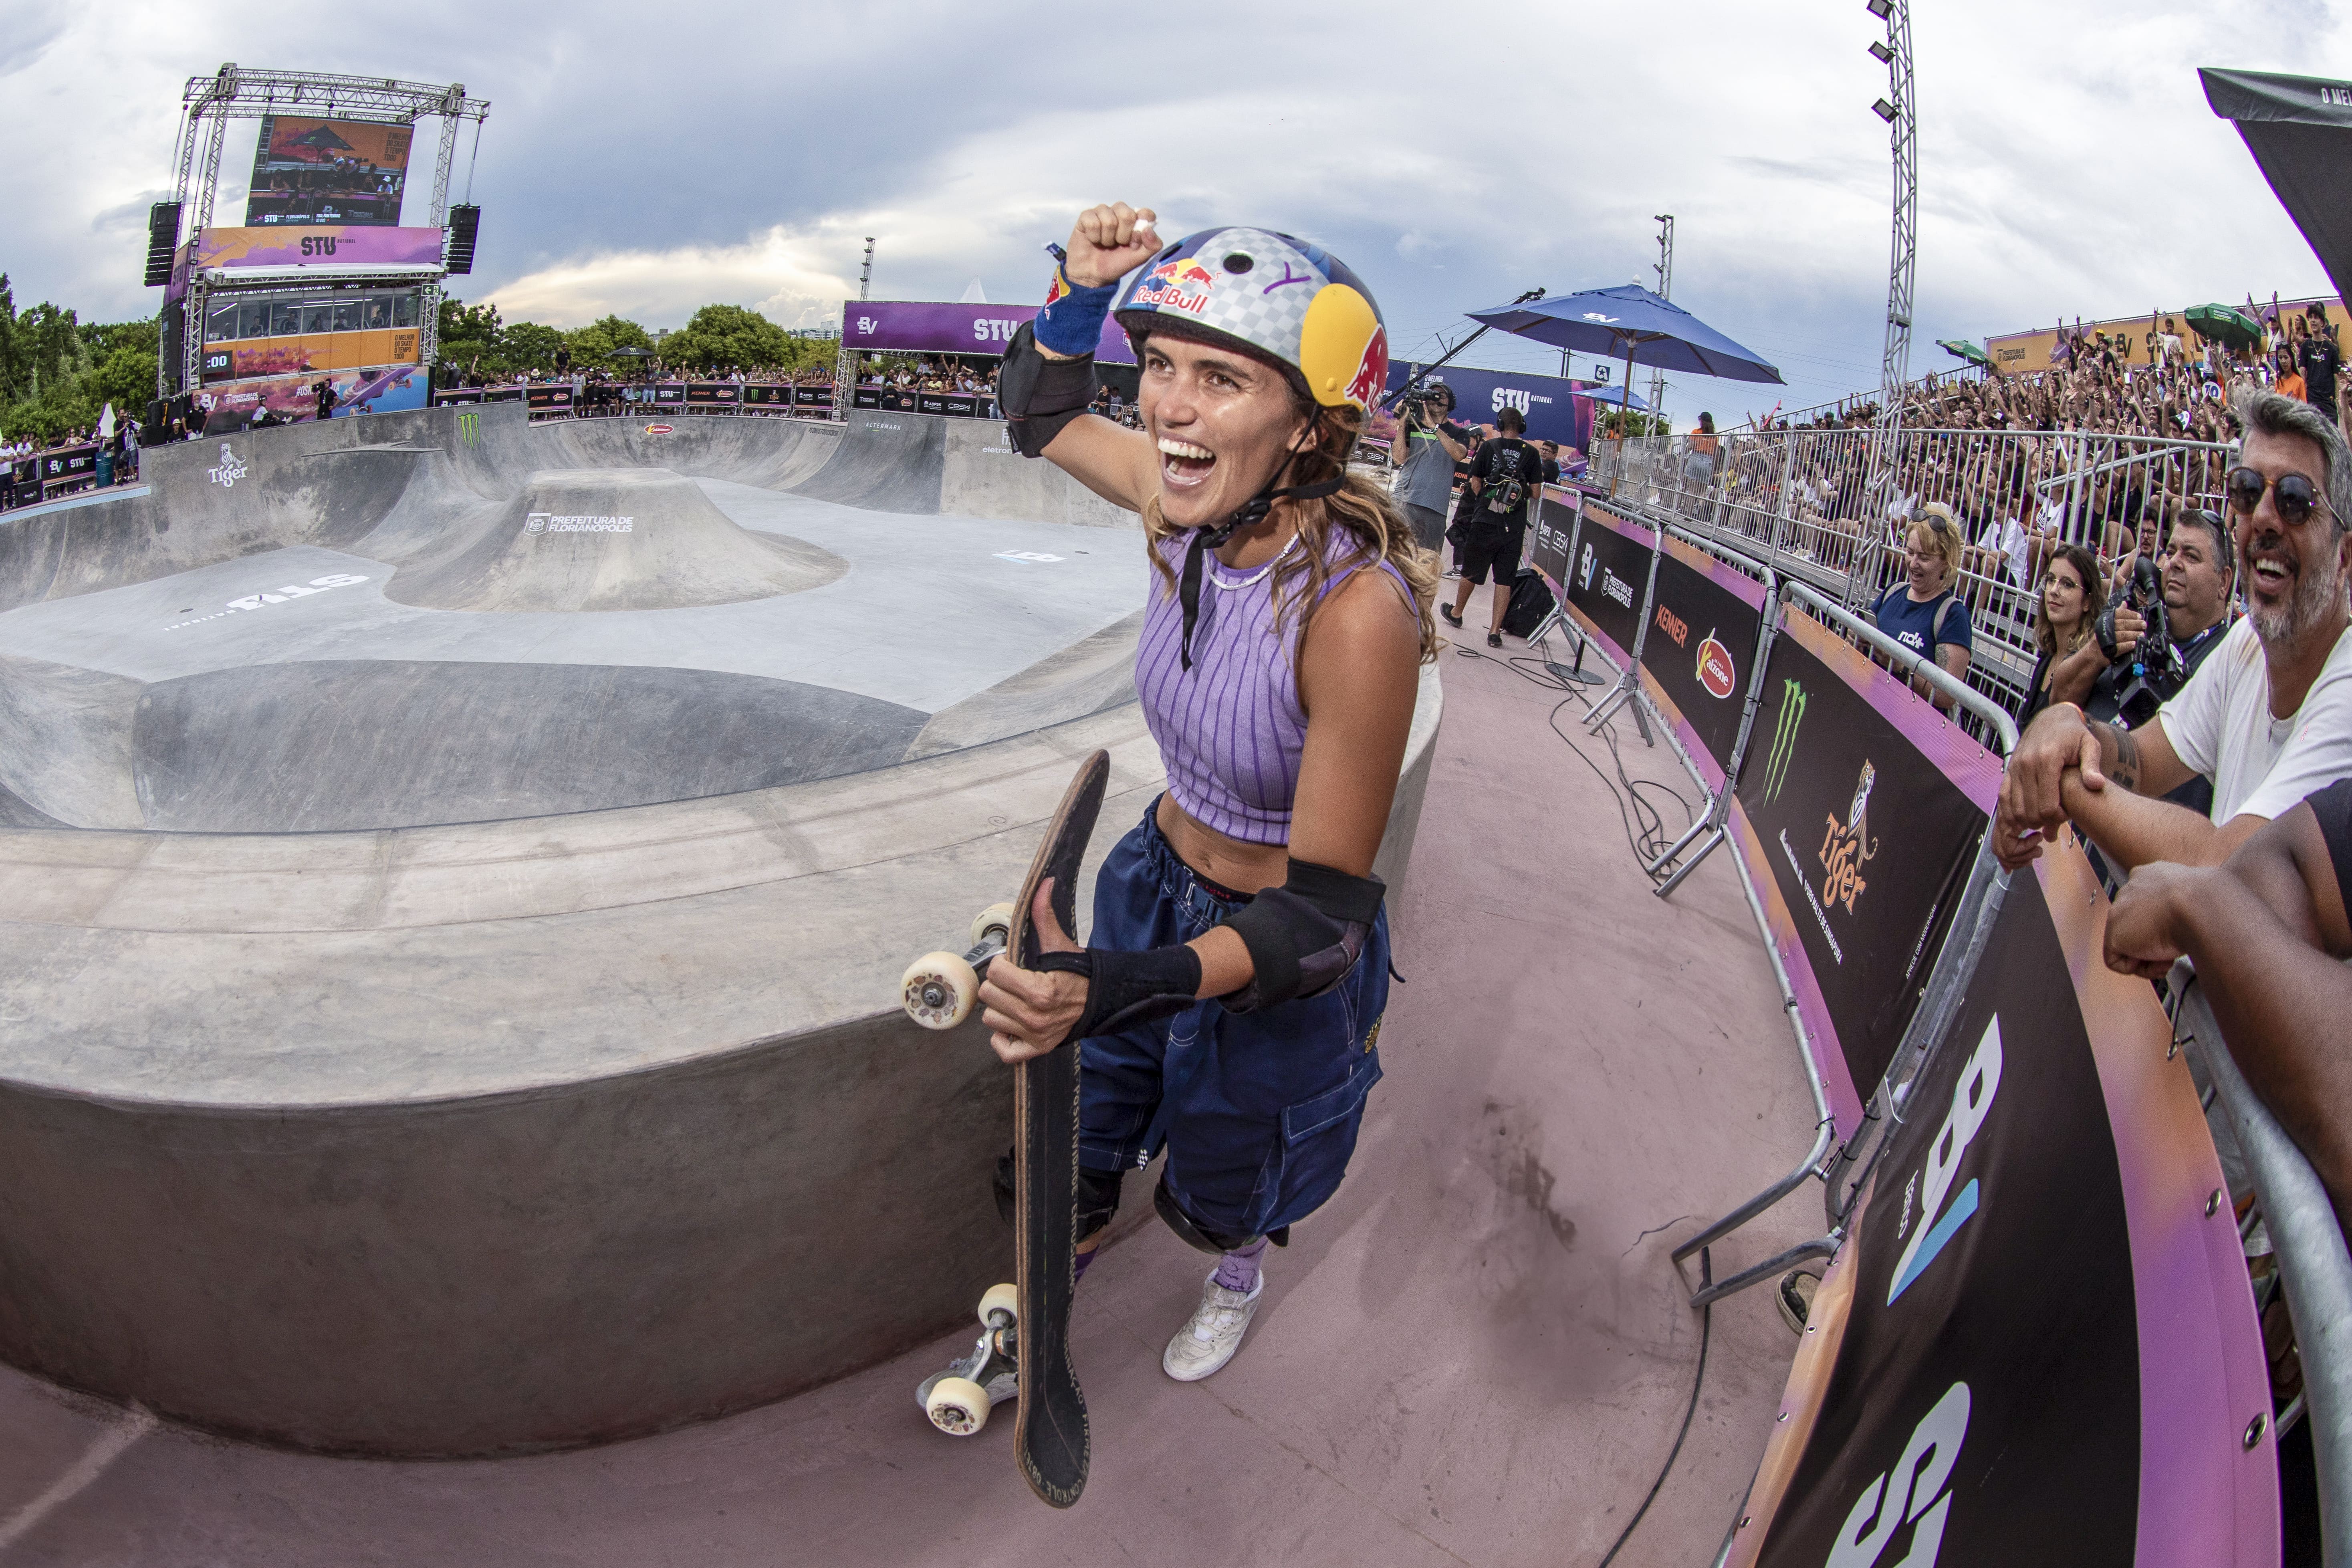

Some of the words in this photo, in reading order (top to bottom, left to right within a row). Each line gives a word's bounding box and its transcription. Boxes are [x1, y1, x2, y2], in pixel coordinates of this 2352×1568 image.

[2321, 88, 2329, 103] O
[264, 215, 278, 223] STU
[301, 236, 336, 256] STU
[1131, 285, 1169, 303] Red
[1164, 289, 1208, 313] Bull
[973, 318, 1019, 342] STU
[1492, 387, 1531, 416] STU
[1531, 395, 1552, 404] NATIONAL
[865, 422, 901, 430] ALTERMARK
[70, 457, 84, 468] STU
[548, 523, 633, 533] FLORIANÓPOLIS
[550, 516, 617, 525] PREFEITURA
[617, 517, 634, 525] DE
[1609, 575, 1628, 594] PREFEITURA
[1628, 586, 1633, 598] DE
[161, 609, 236, 631] NATIONAL
[1654, 604, 1688, 648] KENNER
[1696, 628, 1729, 686] Kalzone
[1714, 658, 1724, 670] MINI
[1818, 811, 1867, 915] Tiger
[1805, 884, 1814, 902] PURO
[1811, 898, 1823, 922] MALTE
[1820, 916, 1827, 930] DE
[1824, 924, 1843, 965] SINGAPURA
[1906, 954, 1917, 979] APRECIE
[1071, 1084, 1080, 1196] POSITIVIDADE
[1046, 1478, 1083, 1503] CONTROLE
